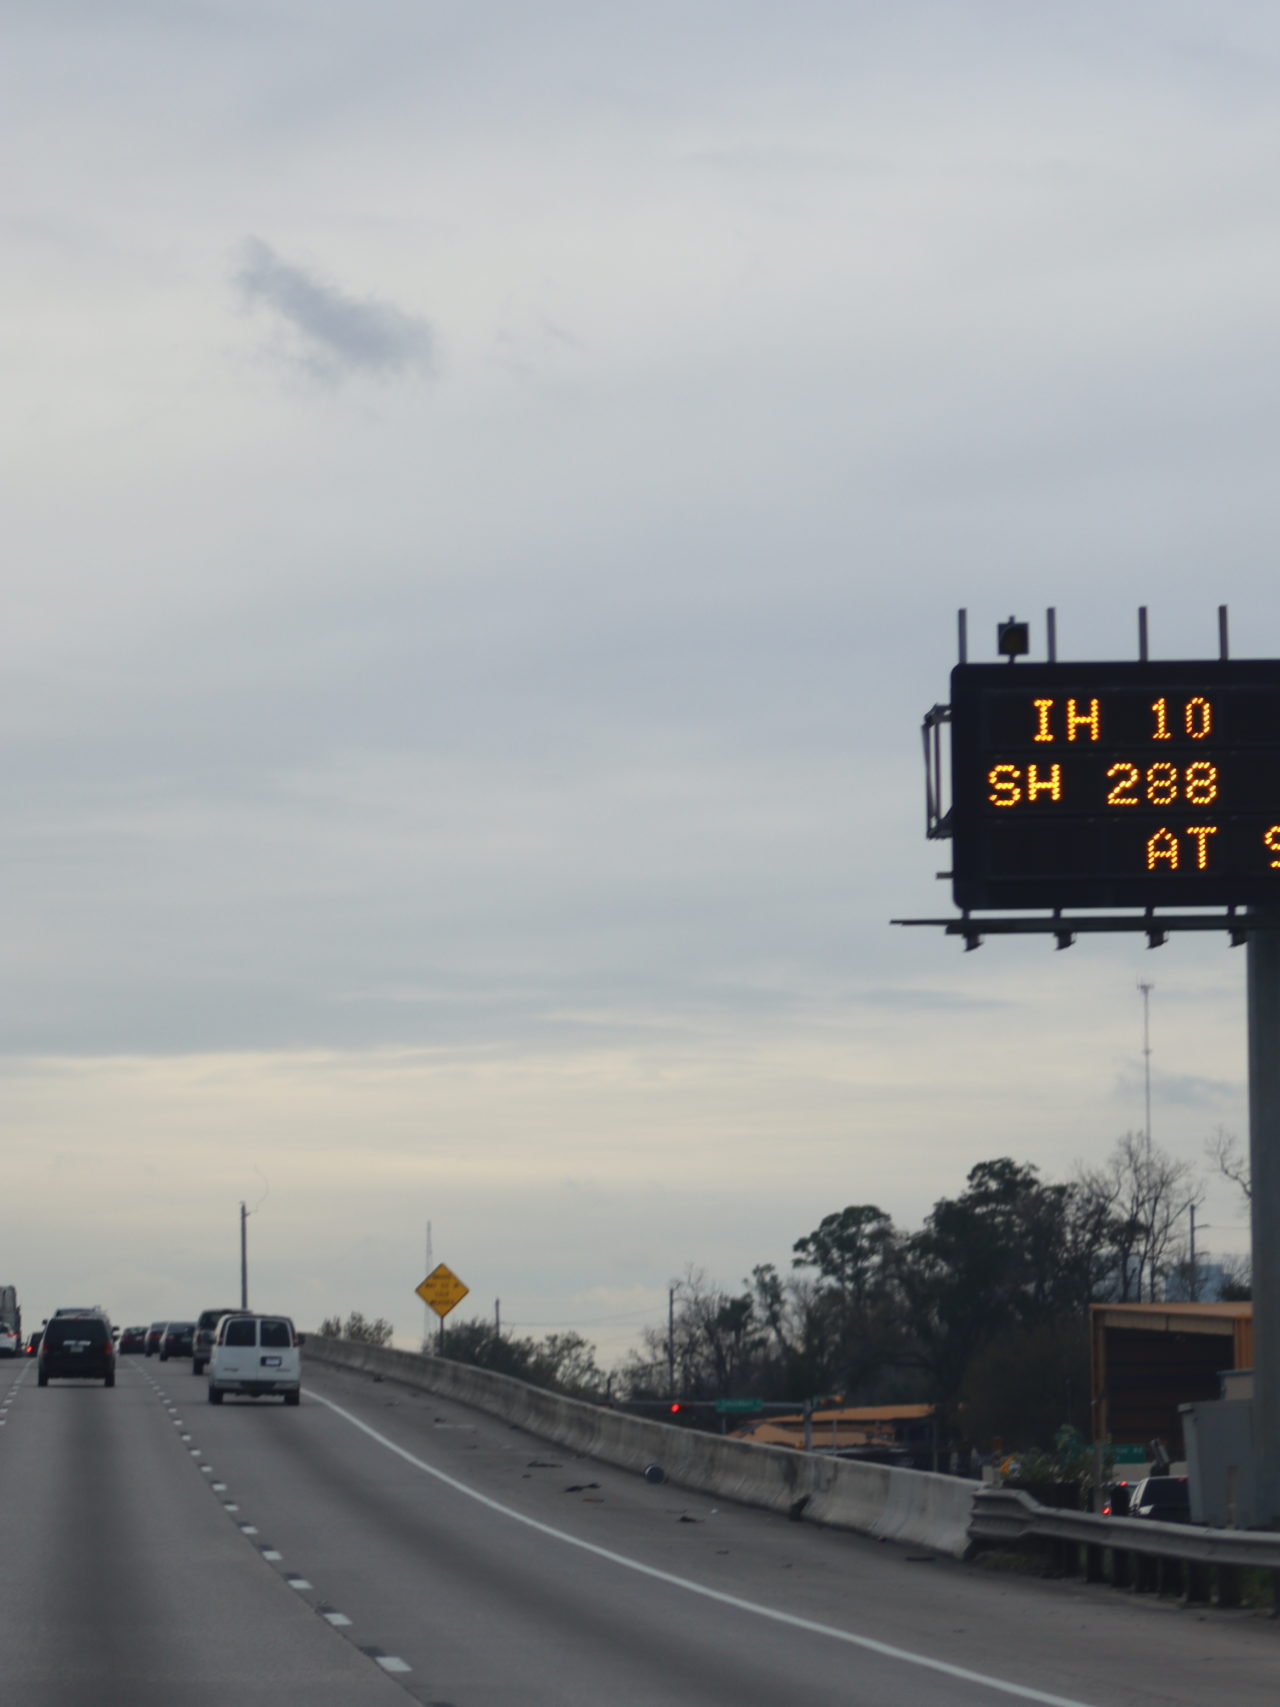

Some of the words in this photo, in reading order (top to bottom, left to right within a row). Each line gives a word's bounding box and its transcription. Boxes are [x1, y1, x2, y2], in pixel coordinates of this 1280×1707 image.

[1033, 698, 1100, 742] IH
[1151, 697, 1211, 740] 10
[988, 763, 1062, 807] SH
[1106, 761, 1218, 806] 288
[1146, 826, 1218, 870] AT
